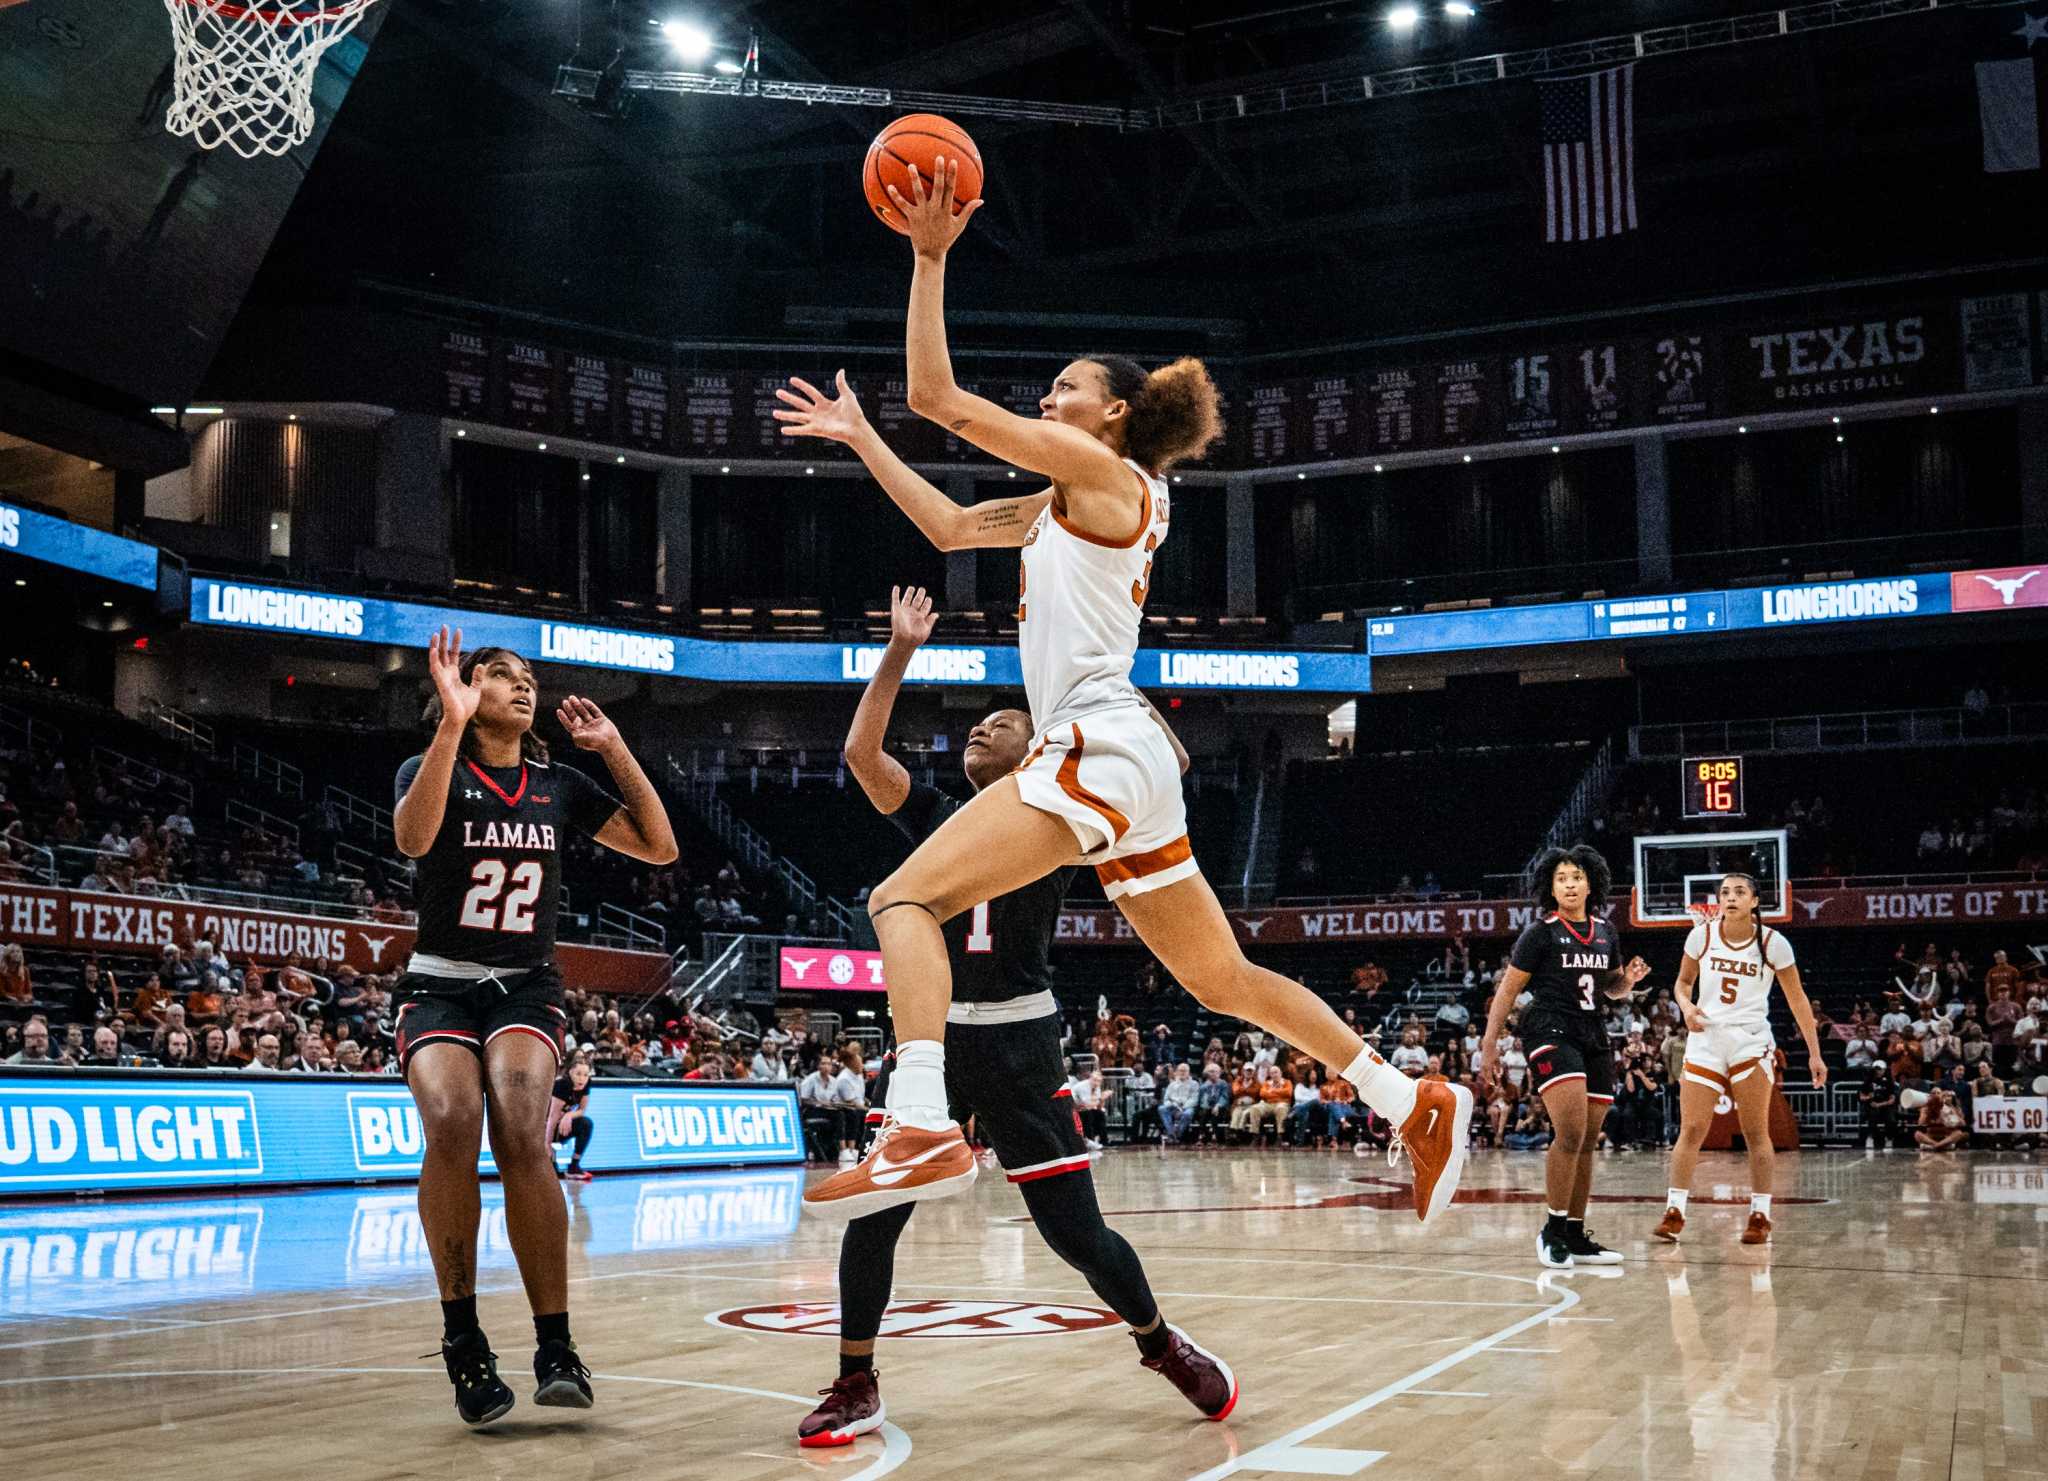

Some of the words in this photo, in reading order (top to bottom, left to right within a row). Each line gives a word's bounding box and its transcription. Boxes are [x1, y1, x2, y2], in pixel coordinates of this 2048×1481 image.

[1750, 317, 1924, 378] TEXAS
[1511, 355, 1551, 400] 15
[1775, 373, 1904, 398] BASKETBALL
[208, 584, 364, 636] LONGHORNS
[1762, 579, 1918, 623] LONGHORNS
[541, 624, 675, 671] LONGHORNS
[1160, 652, 1299, 687] LONGHORNS
[1699, 762, 1737, 780] 8:05
[1706, 781, 1732, 810] 16
[464, 821, 556, 851] LAMAR
[459, 858, 543, 934] 22
[1865, 893, 1954, 919] HOME
[1964, 891, 2003, 916] OF
[71, 901, 174, 945] TEXAS
[965, 900, 993, 954] 1
[1301, 909, 1446, 936] WELCOME
[1457, 908, 1496, 932] TO
[1561, 953, 1609, 969] LAMAR
[1710, 957, 1758, 977] TEXAS
[1578, 974, 1596, 1010] 3
[1719, 976, 1740, 1005] 5
[82, 1105, 247, 1162] LIGHT
[640, 1106, 706, 1148] BUD
[708, 1106, 788, 1146] LIGHT
[1978, 1109, 2016, 1129] LET'S
[2022, 1109, 2042, 1129] GO
